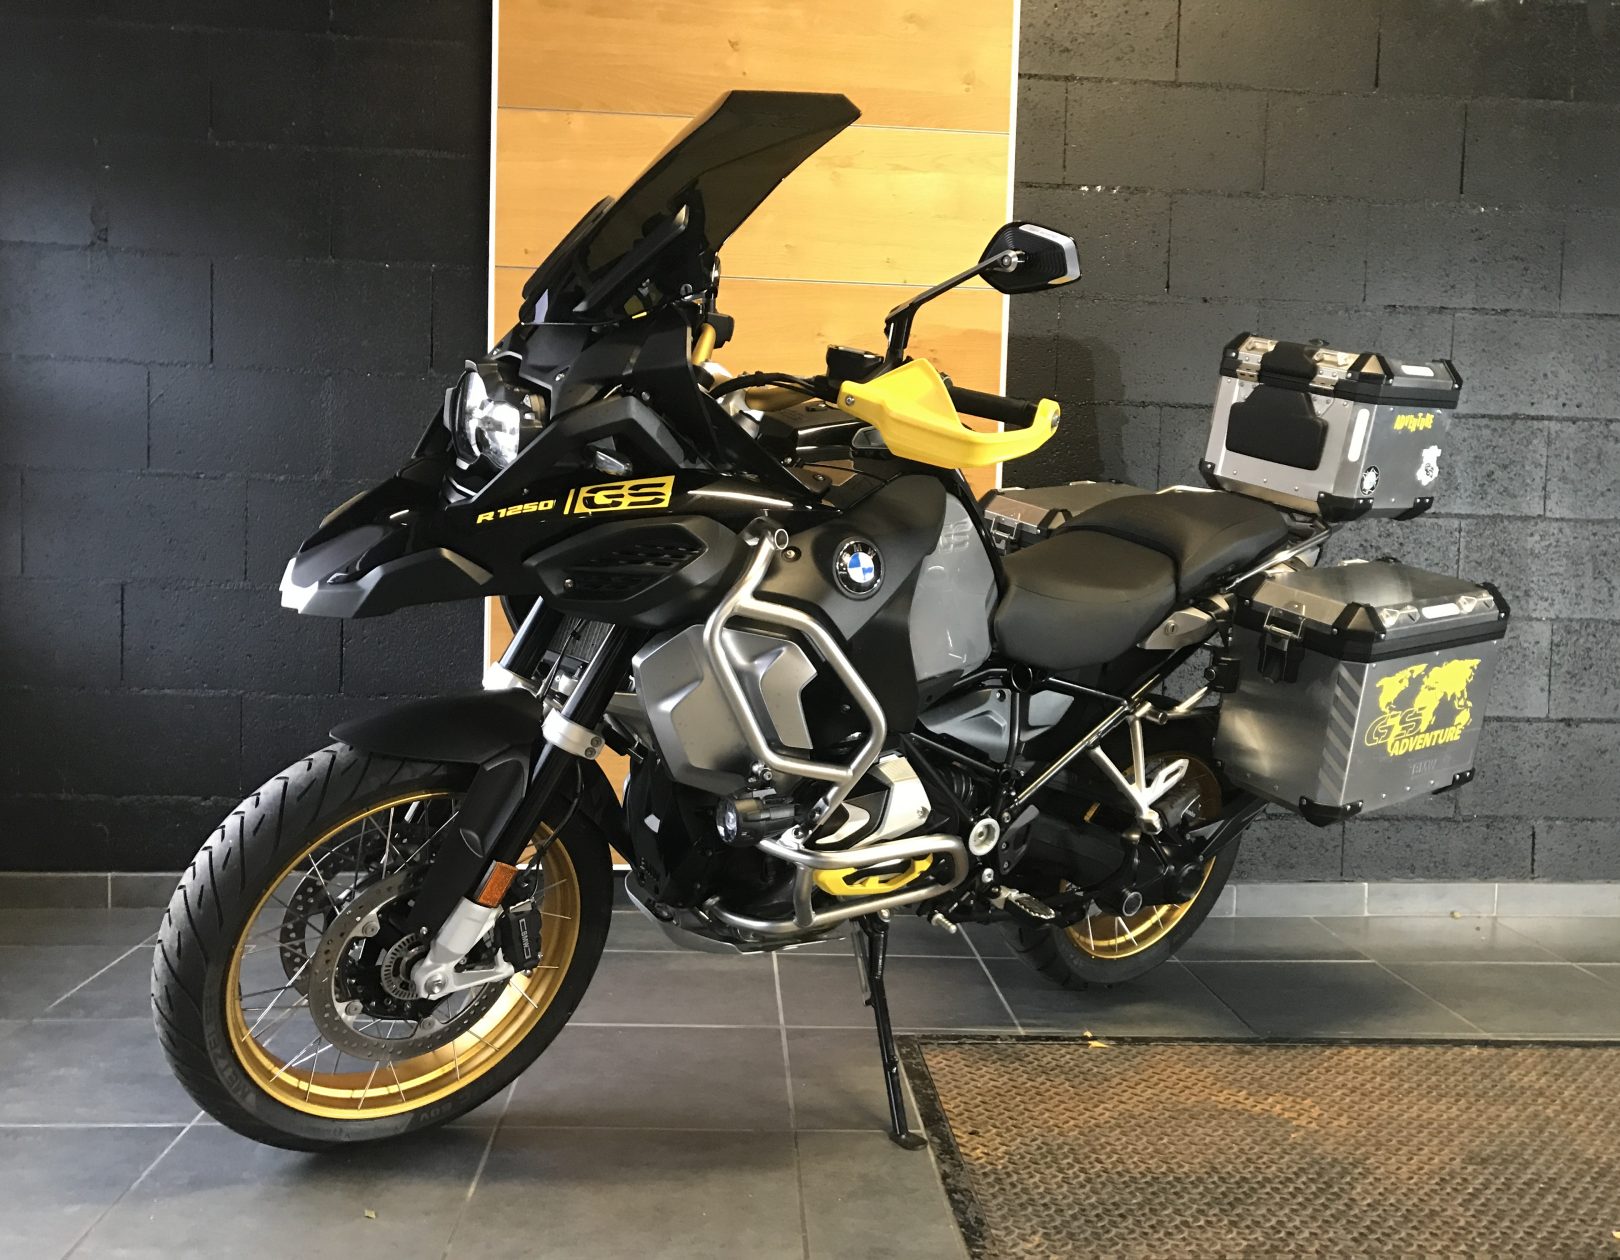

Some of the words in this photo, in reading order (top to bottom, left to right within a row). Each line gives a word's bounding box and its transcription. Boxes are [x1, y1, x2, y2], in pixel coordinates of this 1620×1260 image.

[476, 511, 493, 523] R
[498, 500, 555, 517] 1250
[582, 483, 667, 509] GS
[1365, 707, 1424, 746] GS
[1390, 726, 1463, 756] ADVENTURE
[521, 930, 530, 948] BMW
